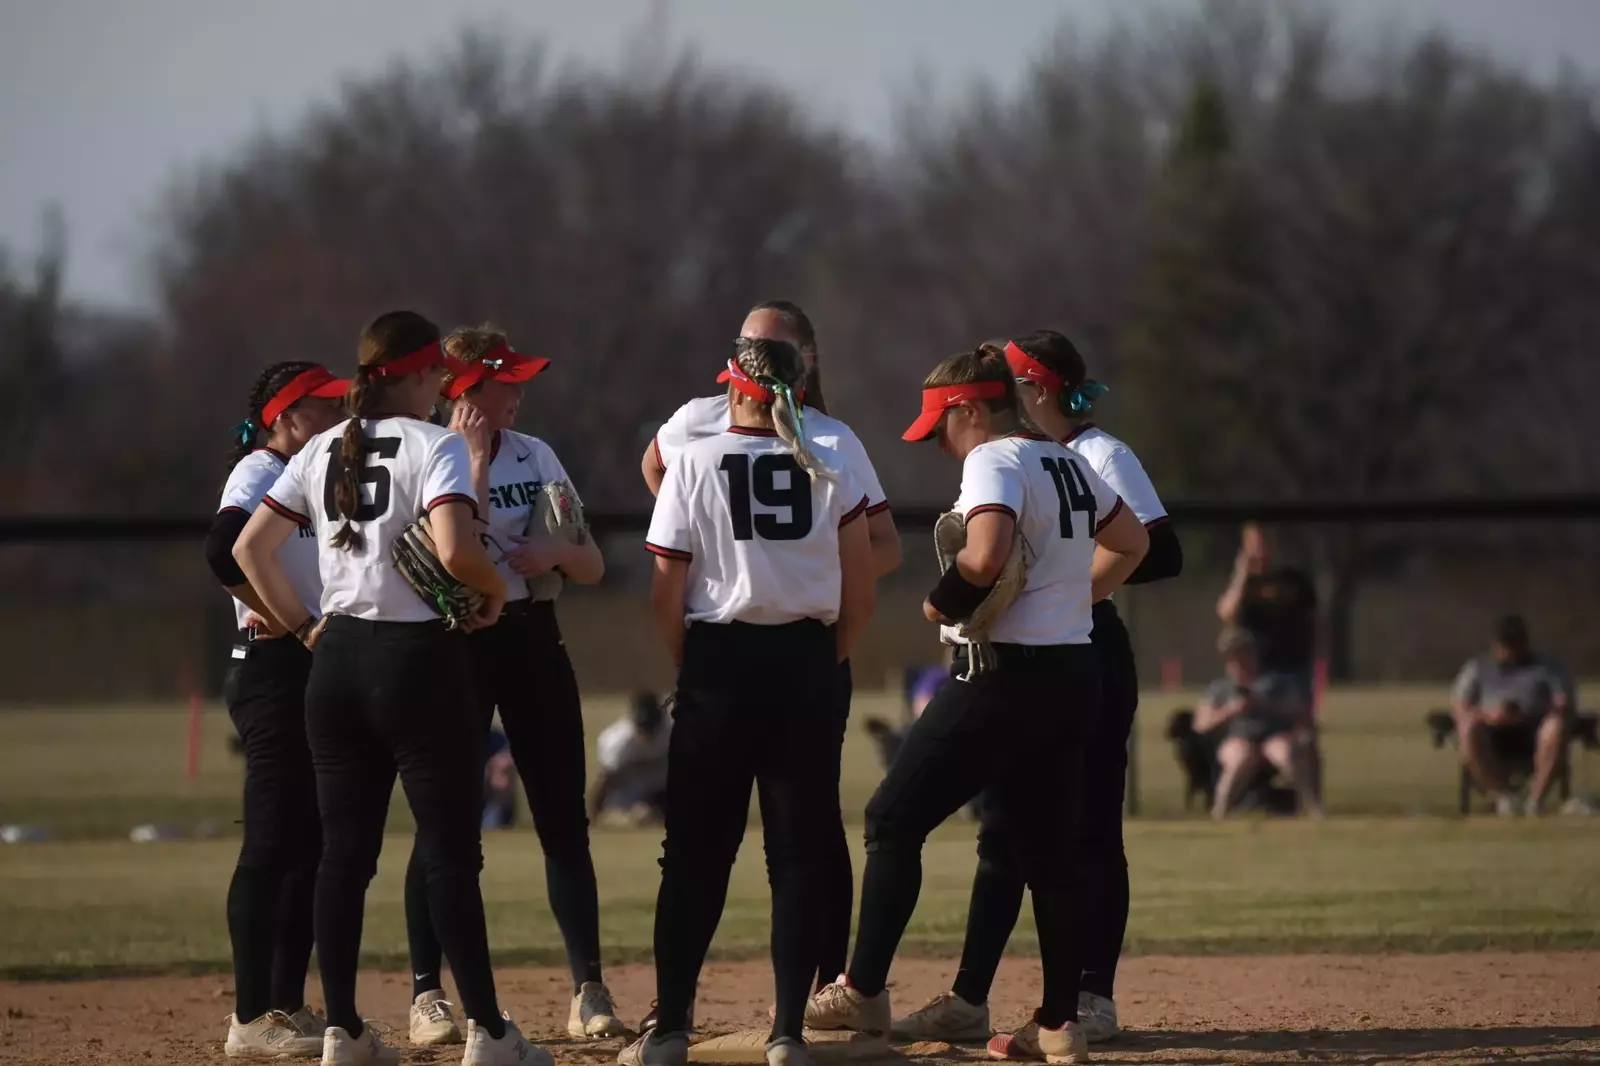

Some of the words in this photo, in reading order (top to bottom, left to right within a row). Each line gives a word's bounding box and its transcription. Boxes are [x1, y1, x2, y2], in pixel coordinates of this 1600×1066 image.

[489, 481, 542, 509] SKIE
[718, 453, 813, 541] 19
[1040, 456, 1097, 539] 14
